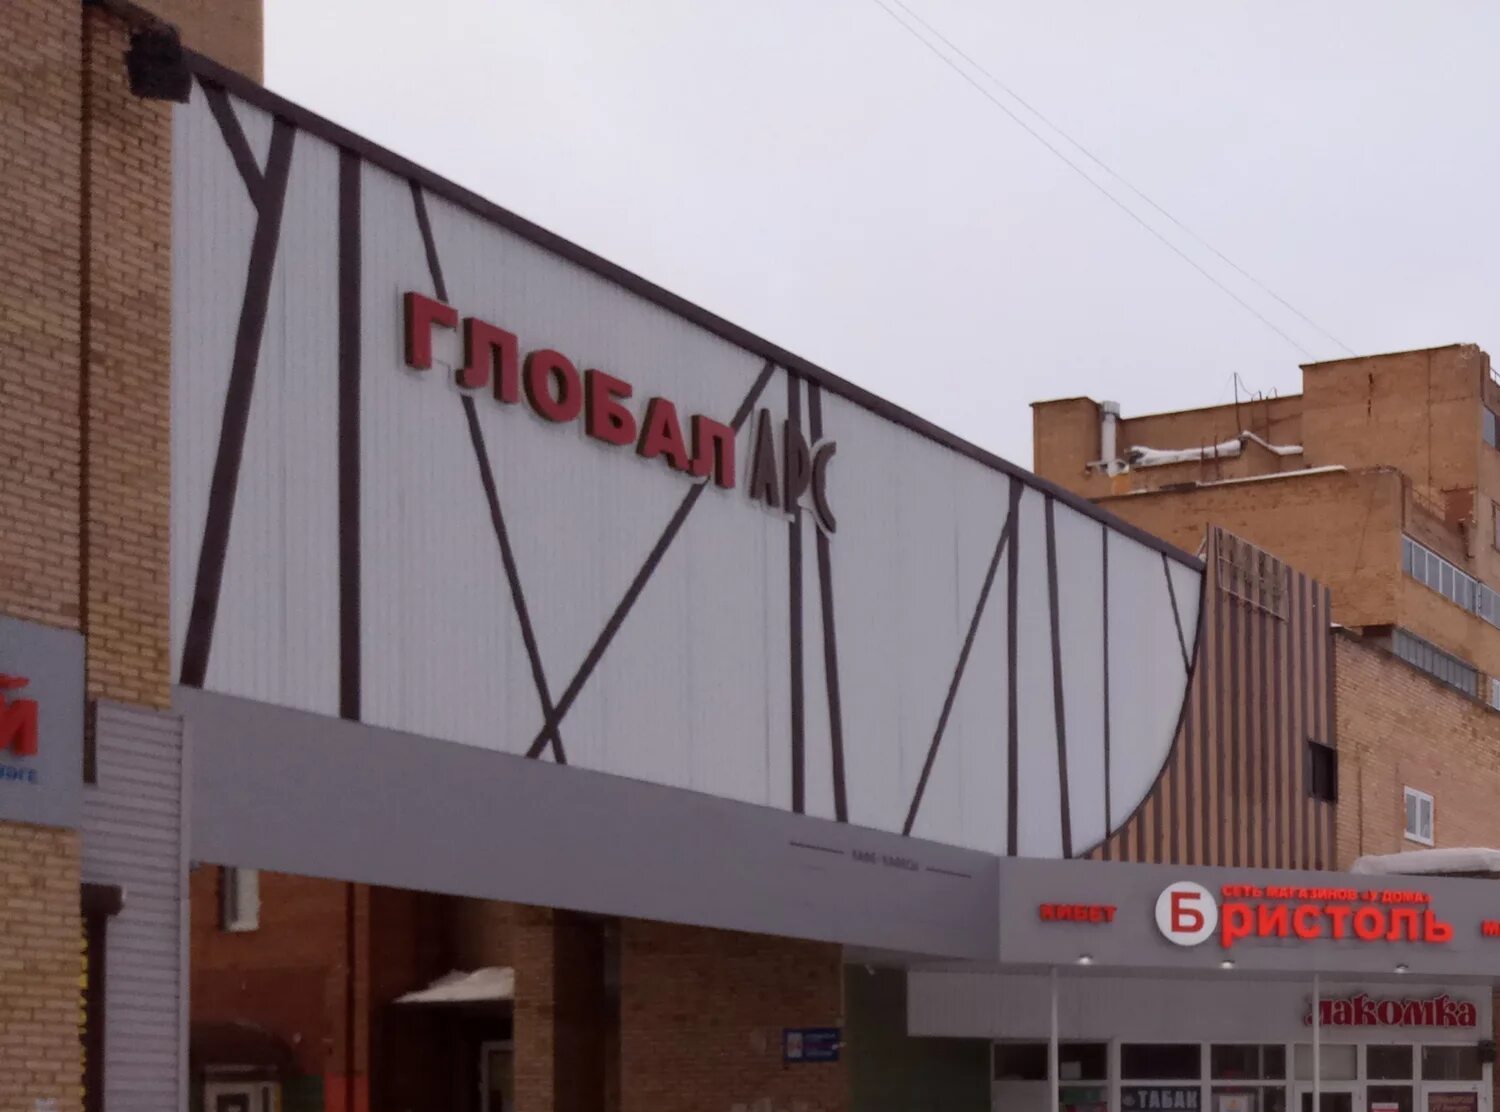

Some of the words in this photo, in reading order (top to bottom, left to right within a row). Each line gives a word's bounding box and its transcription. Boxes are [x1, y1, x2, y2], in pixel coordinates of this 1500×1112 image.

[403, 290, 736, 490] ГЛОБАЛ
[748, 406, 837, 534] АРС
[1266, 886, 1358, 901] МАГАЗИНОВ
[1137, 1090, 1199, 1109] ТАБАК
